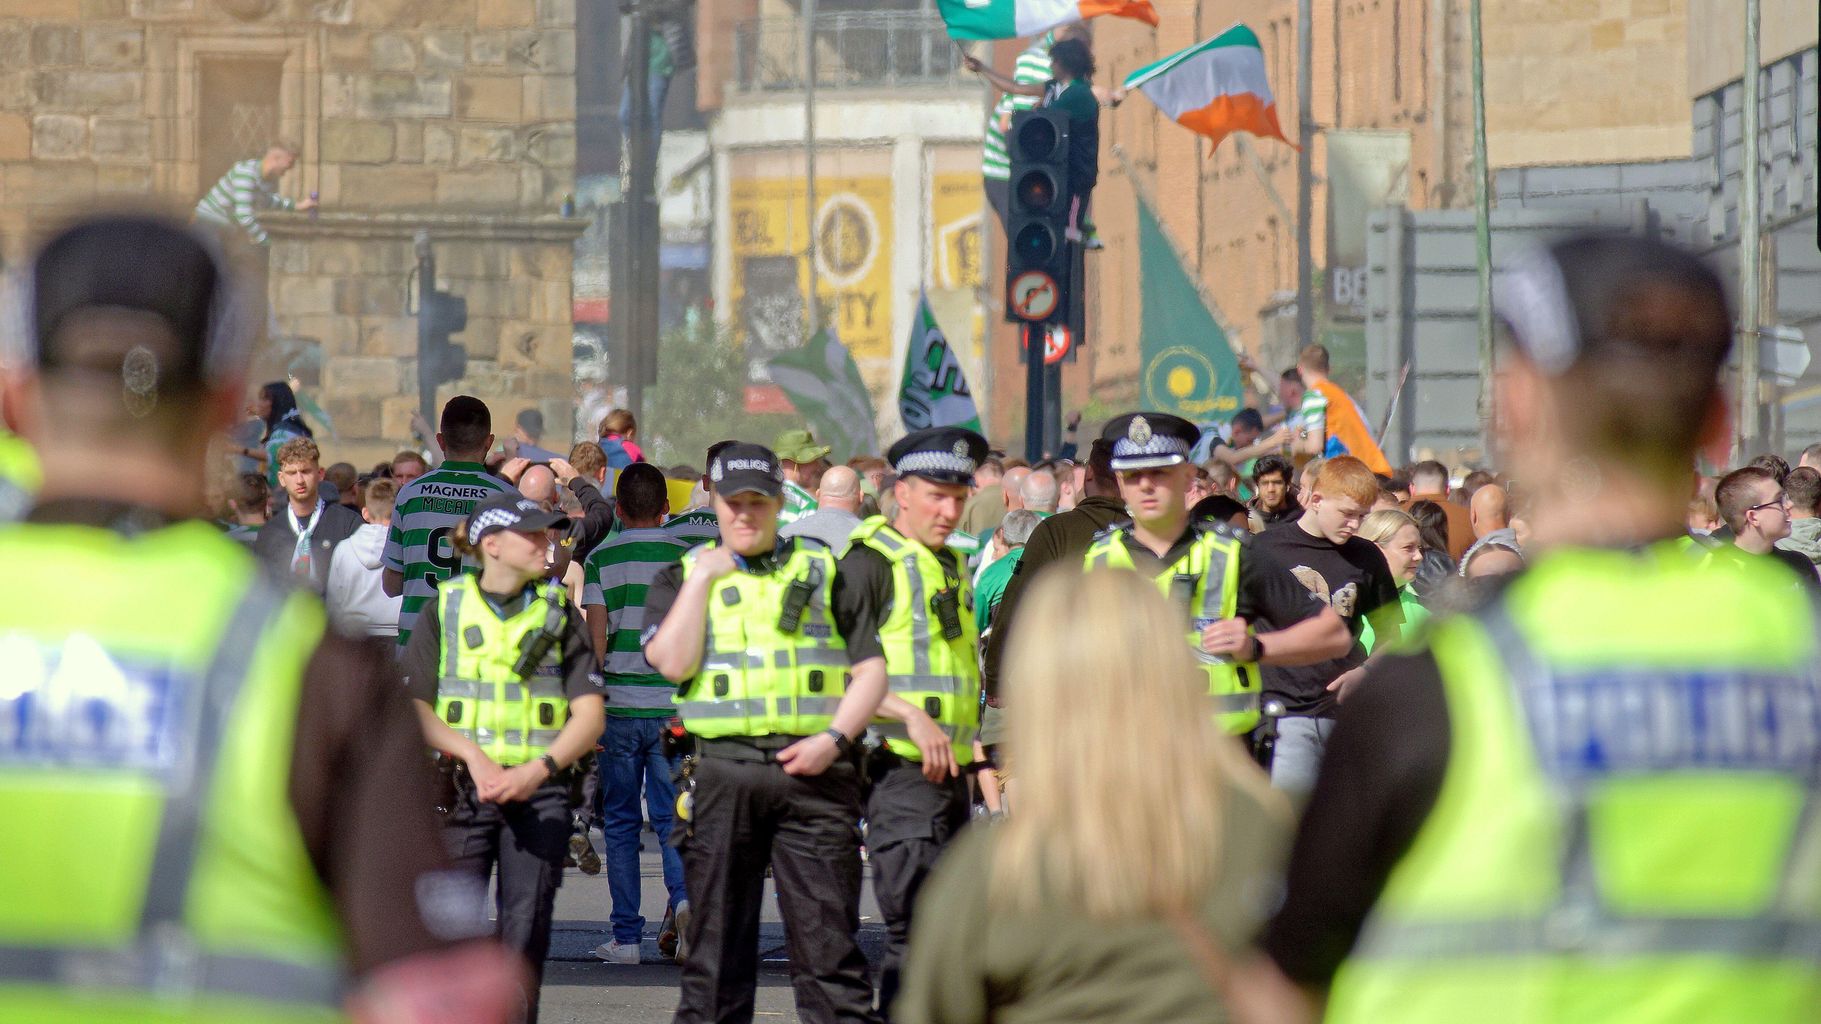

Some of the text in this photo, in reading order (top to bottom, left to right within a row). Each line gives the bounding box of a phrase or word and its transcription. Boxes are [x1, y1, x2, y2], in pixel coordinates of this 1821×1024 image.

[727, 459, 771, 473] POLICE
[420, 484, 488, 499] MAGNERS
[422, 498, 477, 515] MCCAL
[424, 526, 464, 592] 9
